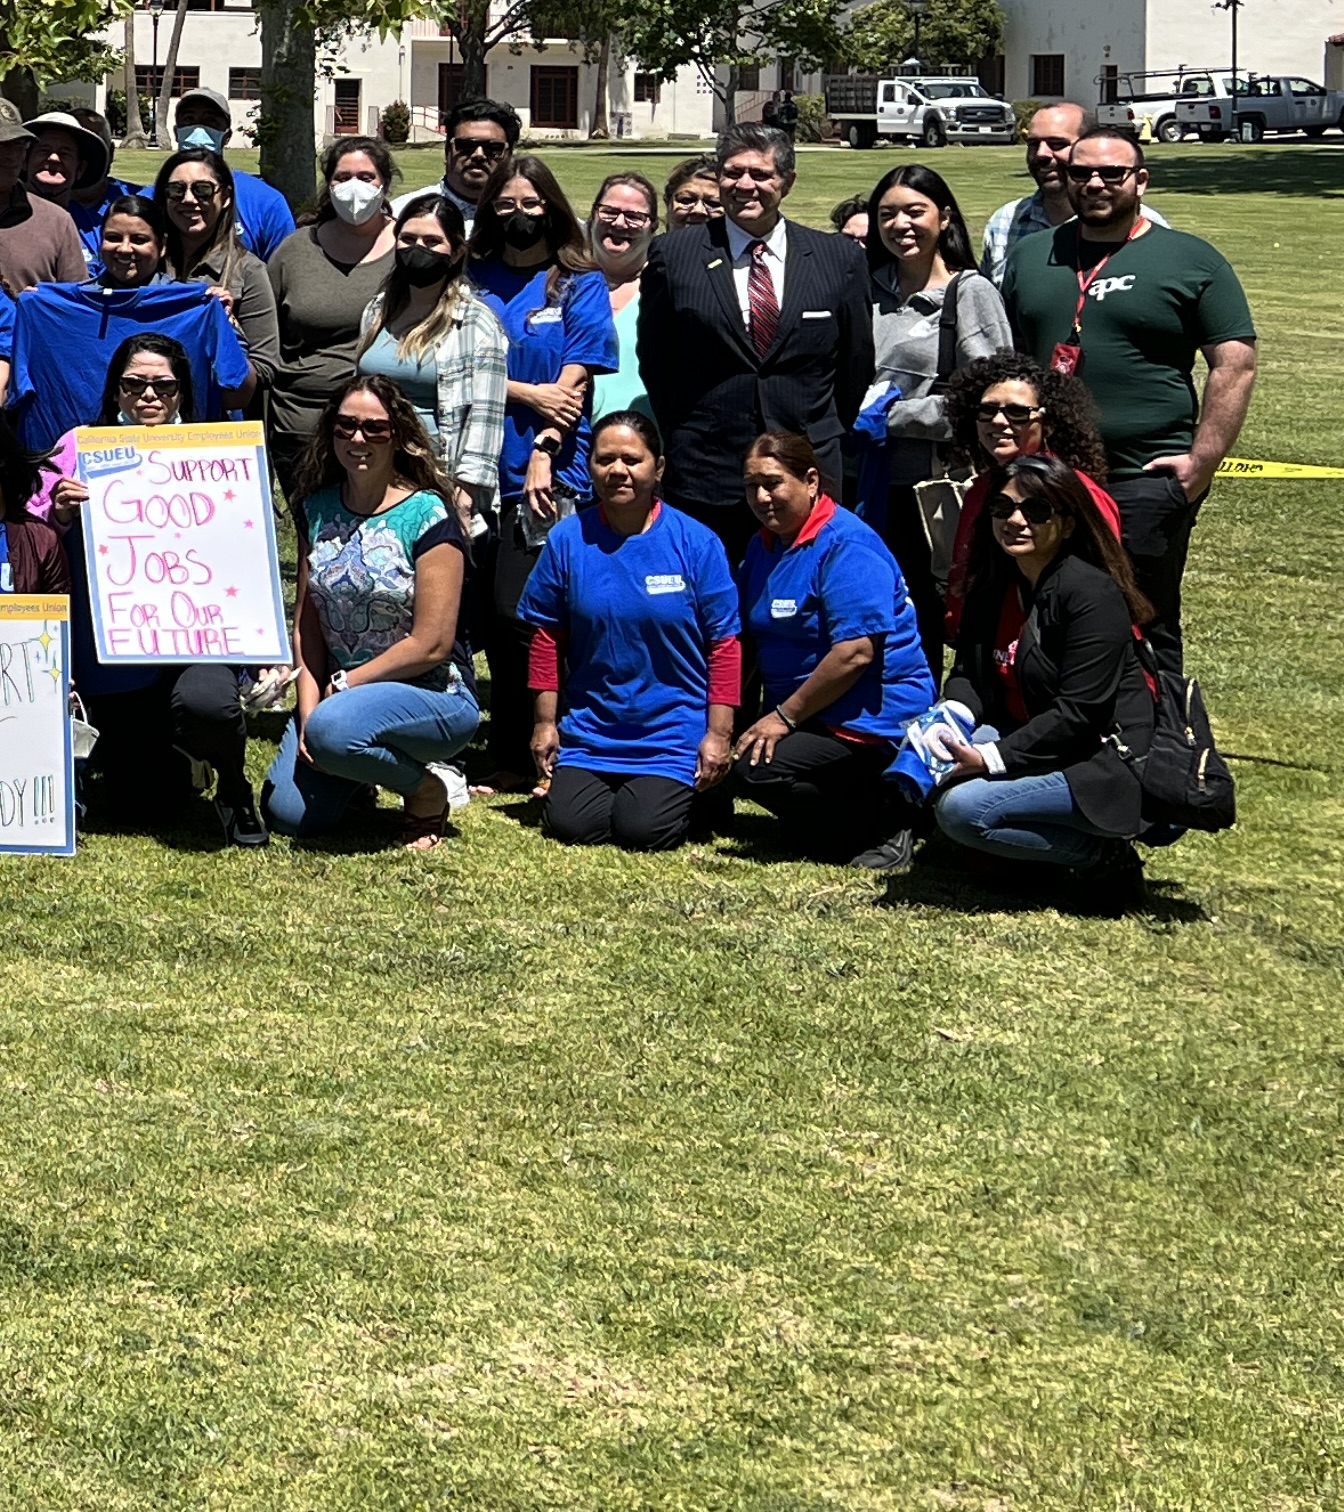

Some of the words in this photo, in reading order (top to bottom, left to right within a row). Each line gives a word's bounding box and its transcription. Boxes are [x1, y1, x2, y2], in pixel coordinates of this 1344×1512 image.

[1088, 274, 1136, 301] apc
[77, 434, 117, 444] California
[119, 433, 140, 443] State
[143, 432, 185, 444] University
[187, 430, 234, 442] Employees
[82, 445, 136, 465] CSUEU
[103, 479, 215, 529] GOOD
[106, 535, 212, 586] JOBS
[43, 602, 67, 613] Union
[107, 591, 161, 628] FOR
[107, 626, 245, 656] FUTURE
